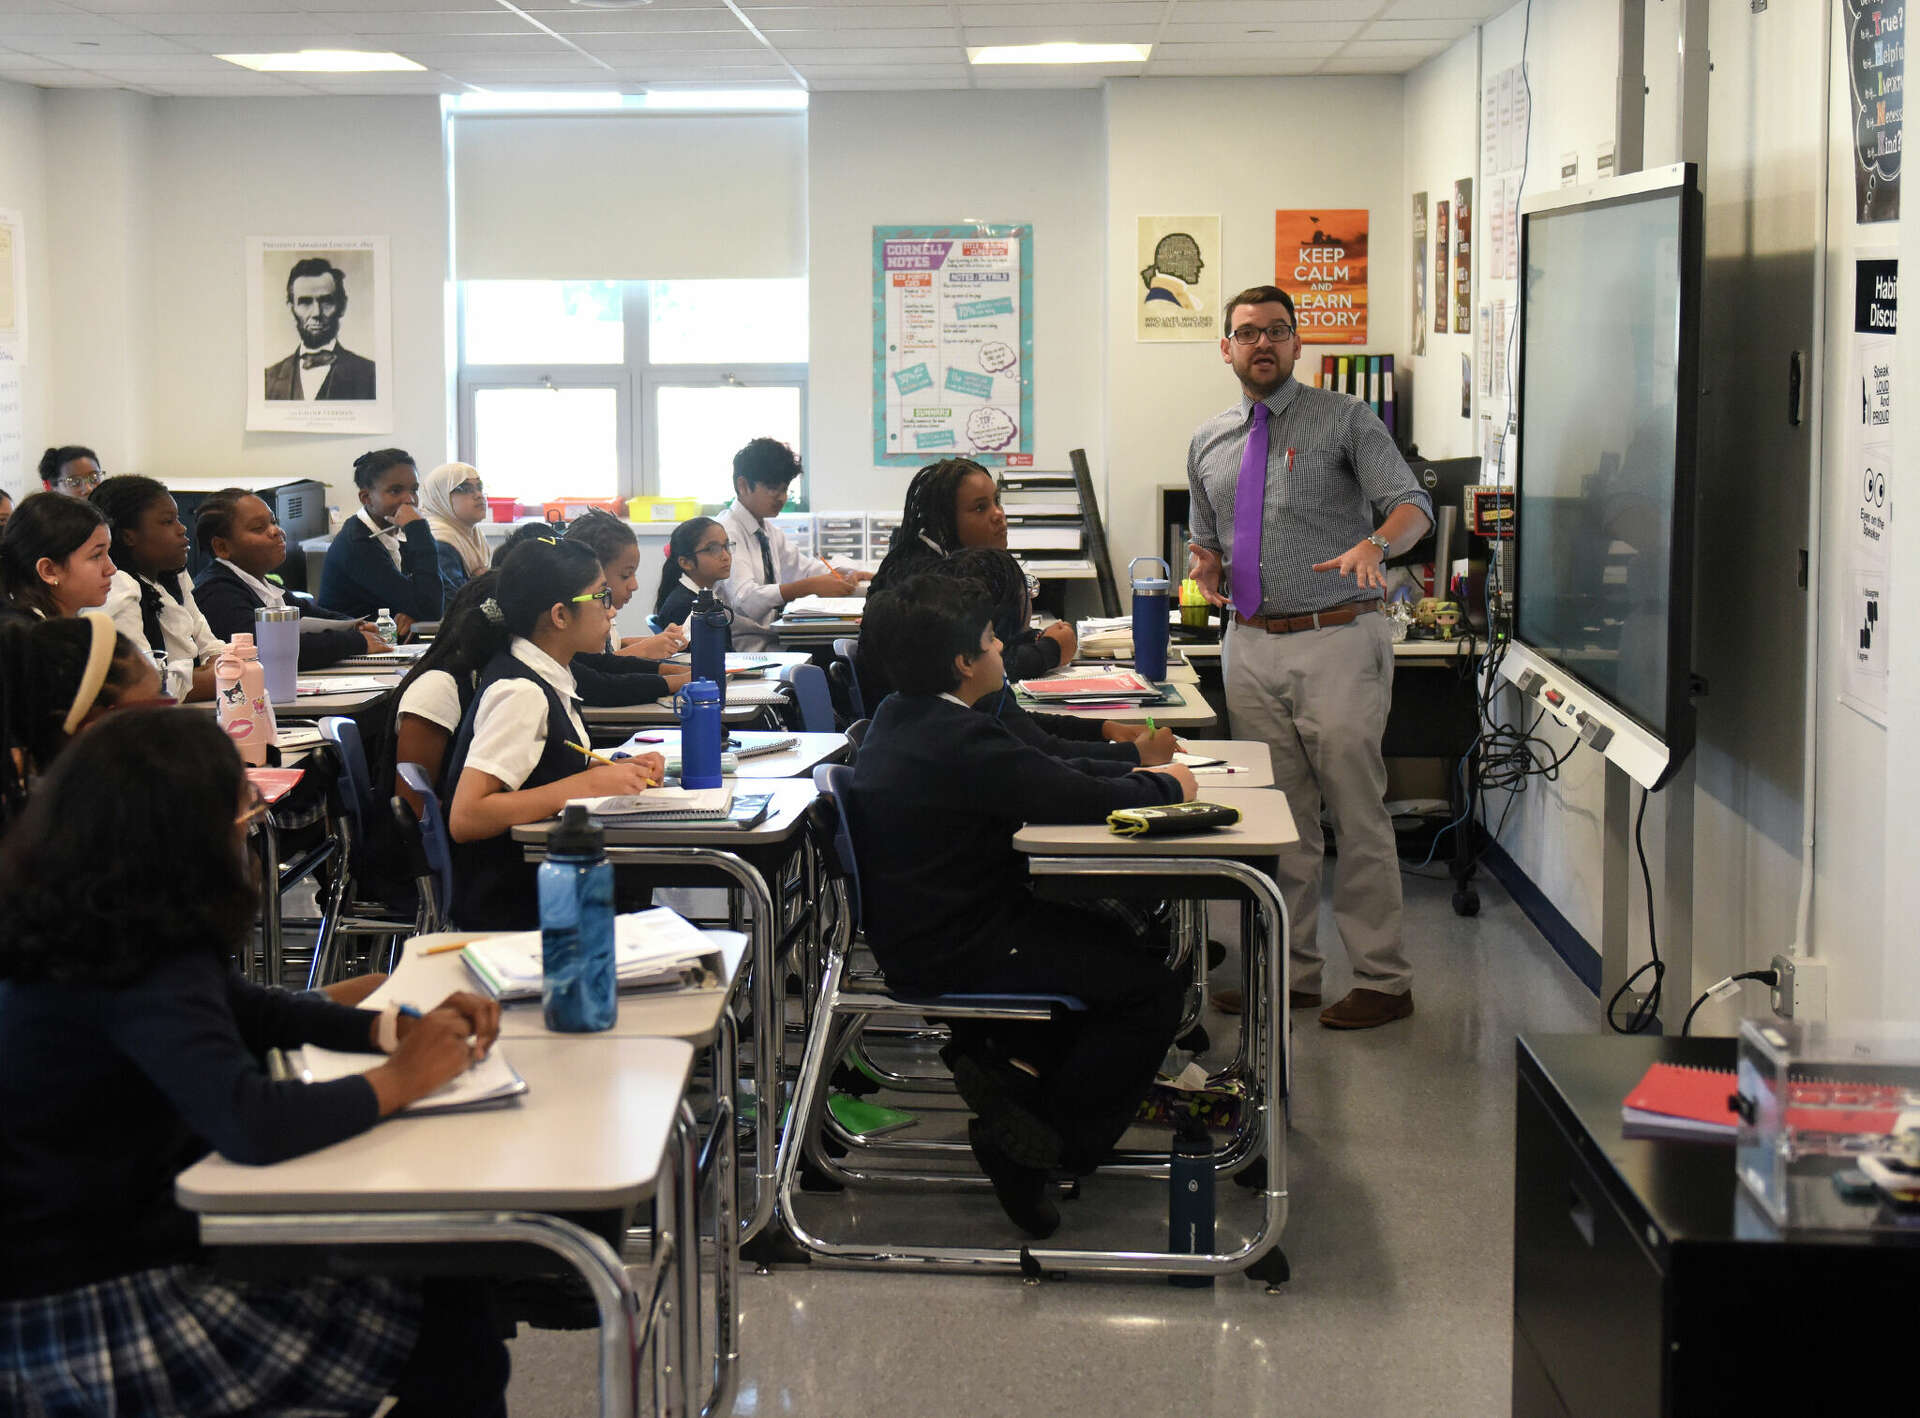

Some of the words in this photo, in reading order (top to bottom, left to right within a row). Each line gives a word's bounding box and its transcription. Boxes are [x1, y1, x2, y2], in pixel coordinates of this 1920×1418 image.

[1872, 8, 1903, 36] True?
[1877, 130, 1902, 156] Kind?
[886, 243, 945, 256] CORNELL
[1299, 247, 1345, 263] KEEP
[887, 256, 930, 268] NOTES
[1294, 264, 1349, 281] CALM
[1310, 283, 1333, 291] AND
[1290, 293, 1352, 309] LEARN
[1295, 311, 1361, 327] ISTORY
[1873, 364, 1889, 378] Speak
[1876, 380, 1889, 393] LOUD
[1880, 396, 1889, 406] And
[1872, 409, 1889, 423] PROUD
[1860, 507, 1870, 523] Eyes
[1871, 514, 1876, 525] on
[1863, 522, 1881, 542] Speaker
